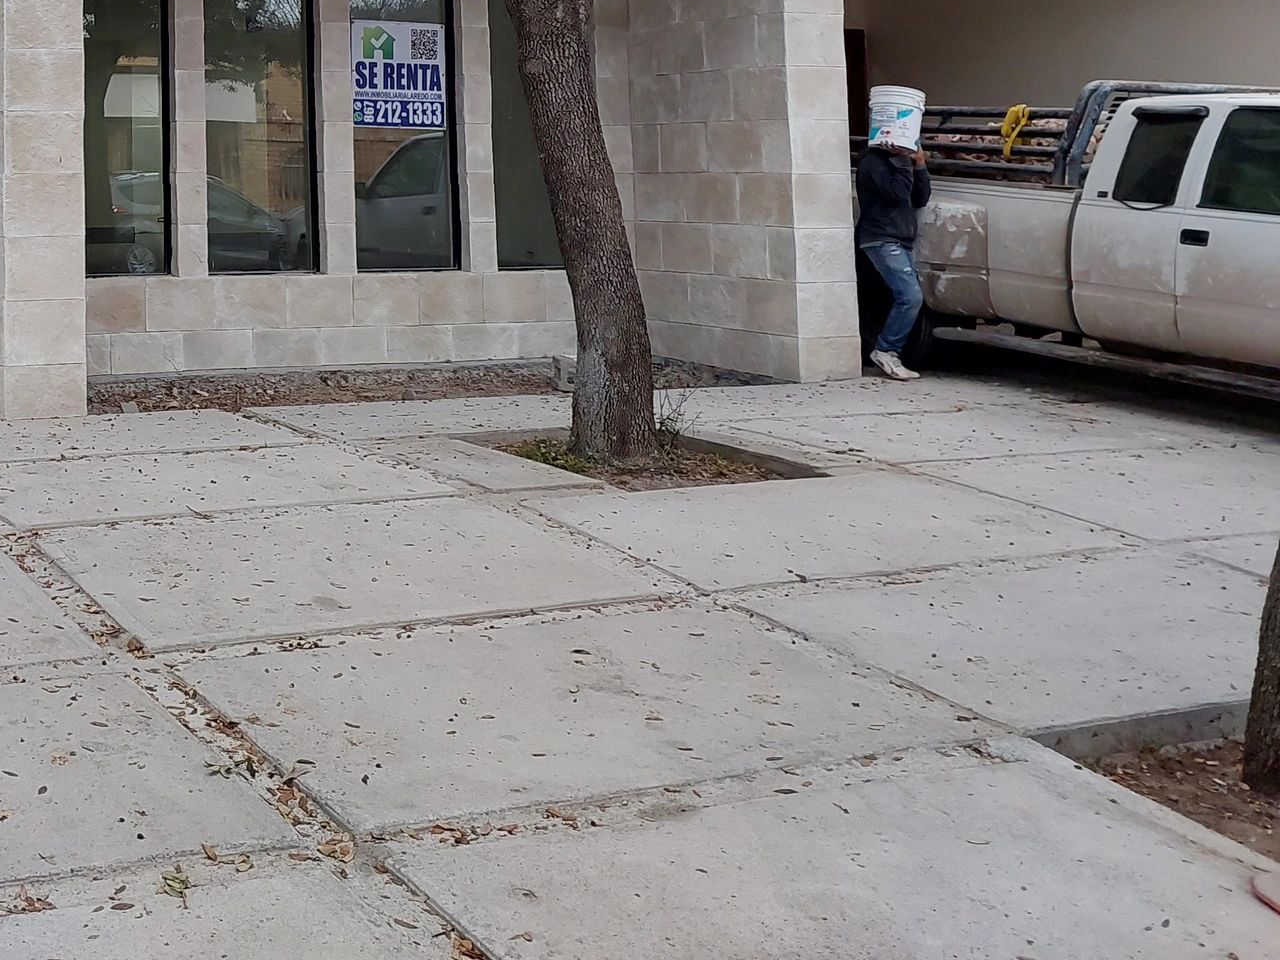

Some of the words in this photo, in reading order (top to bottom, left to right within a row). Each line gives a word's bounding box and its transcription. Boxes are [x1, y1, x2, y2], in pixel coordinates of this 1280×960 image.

[355, 61, 378, 89] SE
[383, 62, 442, 91] RENTA
[354, 90, 442, 100] WWW.INMOBILIARIALAREDO.COM
[363, 101, 375, 123] 867
[376, 100, 442, 125] 212-1333
